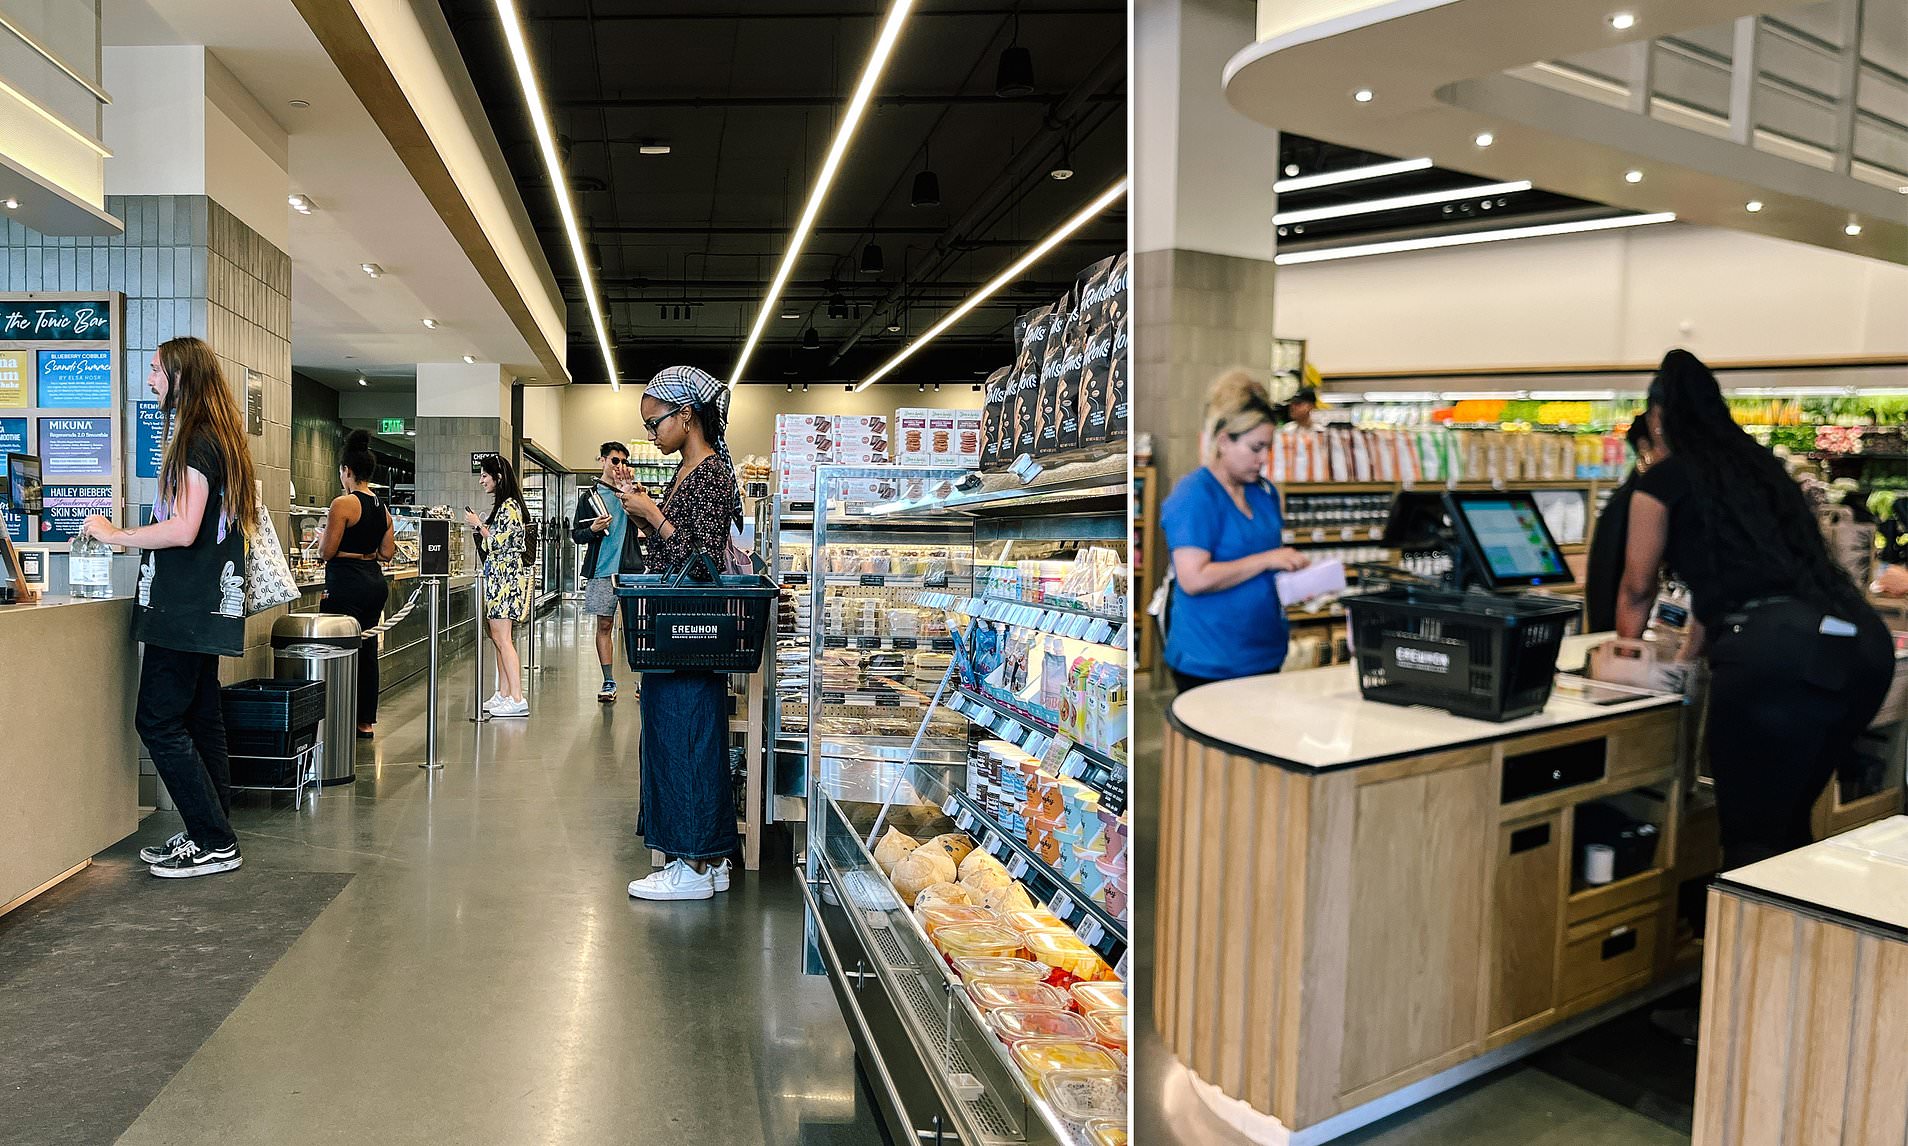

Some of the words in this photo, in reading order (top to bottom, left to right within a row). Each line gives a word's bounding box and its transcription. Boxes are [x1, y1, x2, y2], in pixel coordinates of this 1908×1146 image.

[5, 311, 31, 333] the
[35, 309, 71, 334] Tonic
[73, 308, 108, 334] Bar
[139, 411, 154, 420] Tea
[49, 420, 92, 430] MIKUNA
[50, 487, 78, 497] HAILEY
[79, 487, 112, 497] BIEBER'S
[50, 507, 70, 518] SKIN
[71, 507, 112, 518] SMOOTHIE
[428, 544, 441, 552] EXIT
[671, 624, 718, 634] EREWHON
